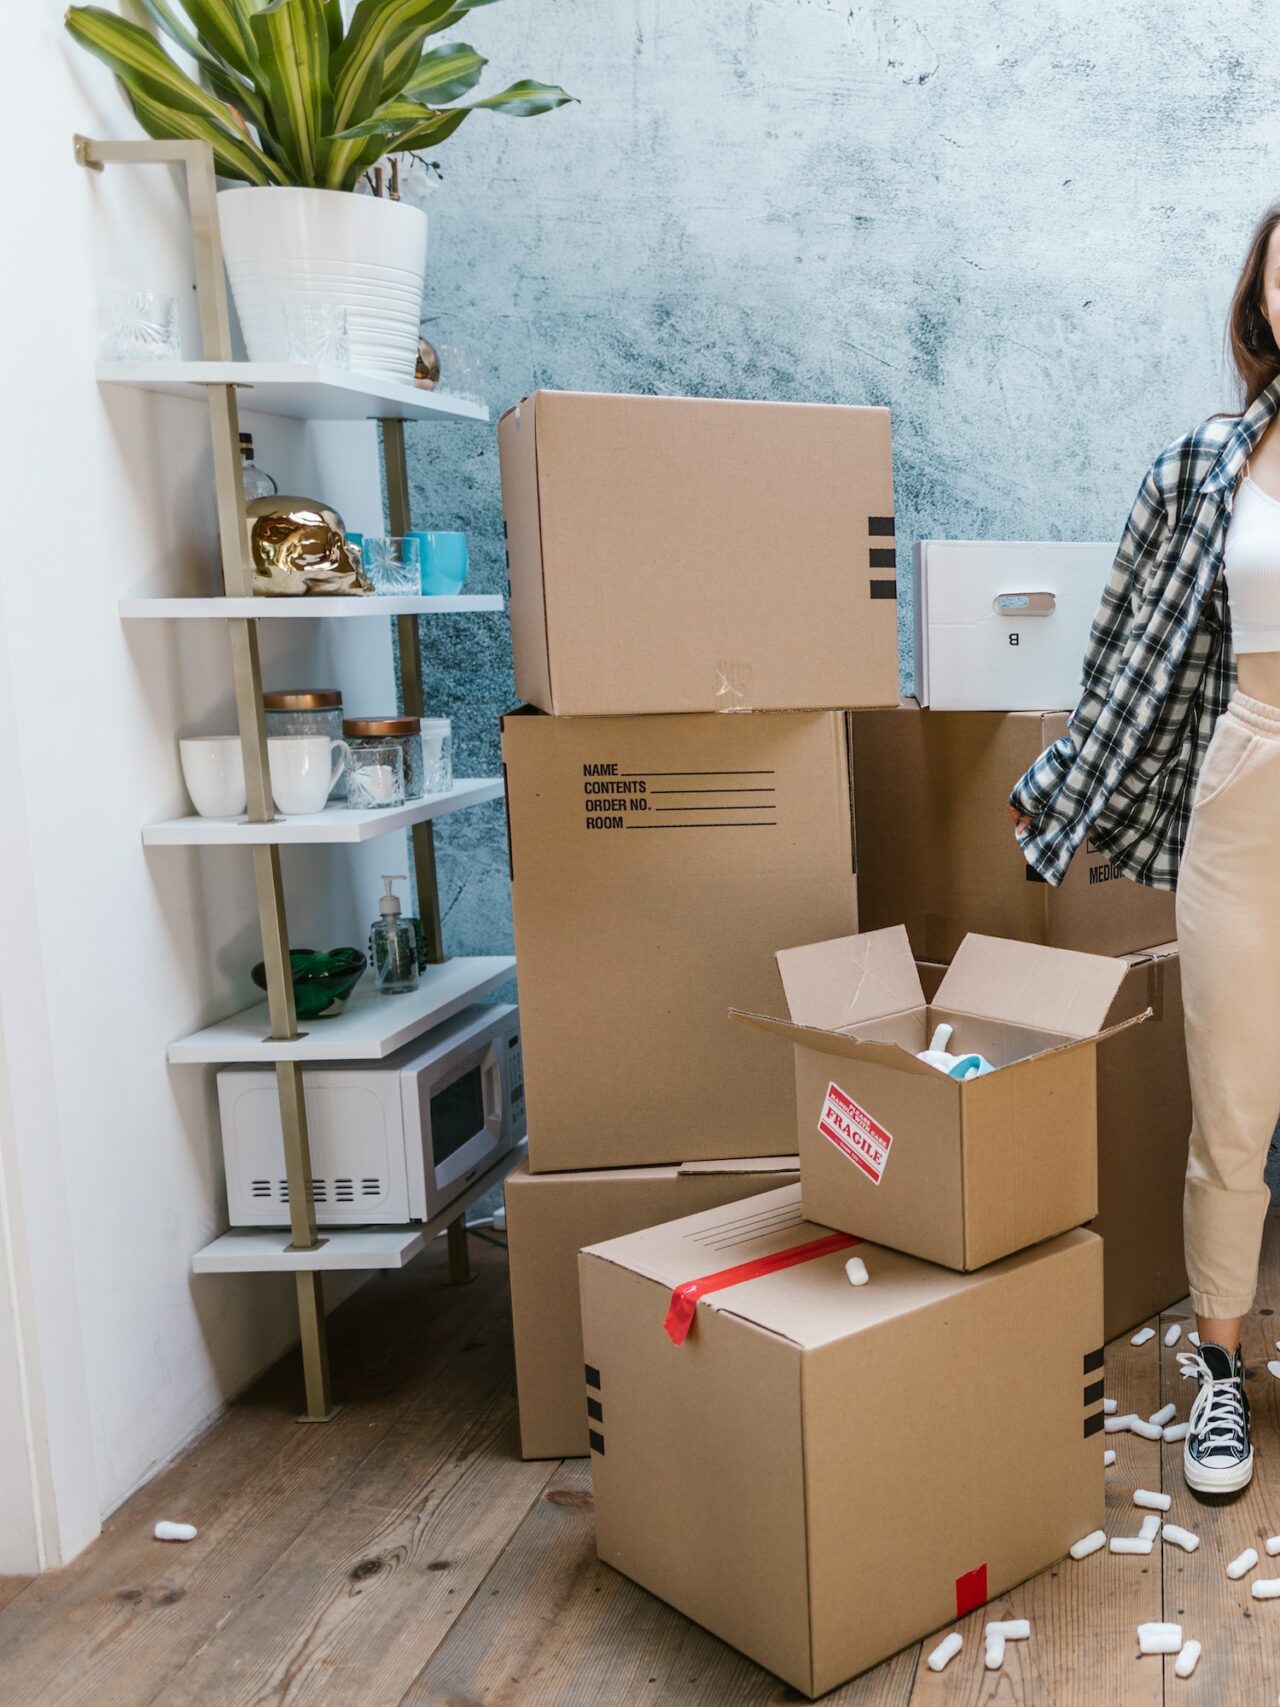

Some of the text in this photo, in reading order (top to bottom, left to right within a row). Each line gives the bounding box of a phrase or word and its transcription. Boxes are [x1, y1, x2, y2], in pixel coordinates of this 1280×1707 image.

[583, 763, 618, 777] NAME
[584, 780, 646, 794] CONTENTS
[585, 798, 652, 812] ORDER NO.
[586, 816, 624, 829] ROOM
[1089, 863, 1125, 885] MEDIU
[830, 1093, 888, 1148] HANDLE WITH CARE
[849, 1103, 872, 1126] PLEASE
[825, 1106, 883, 1166] FRAGILE
